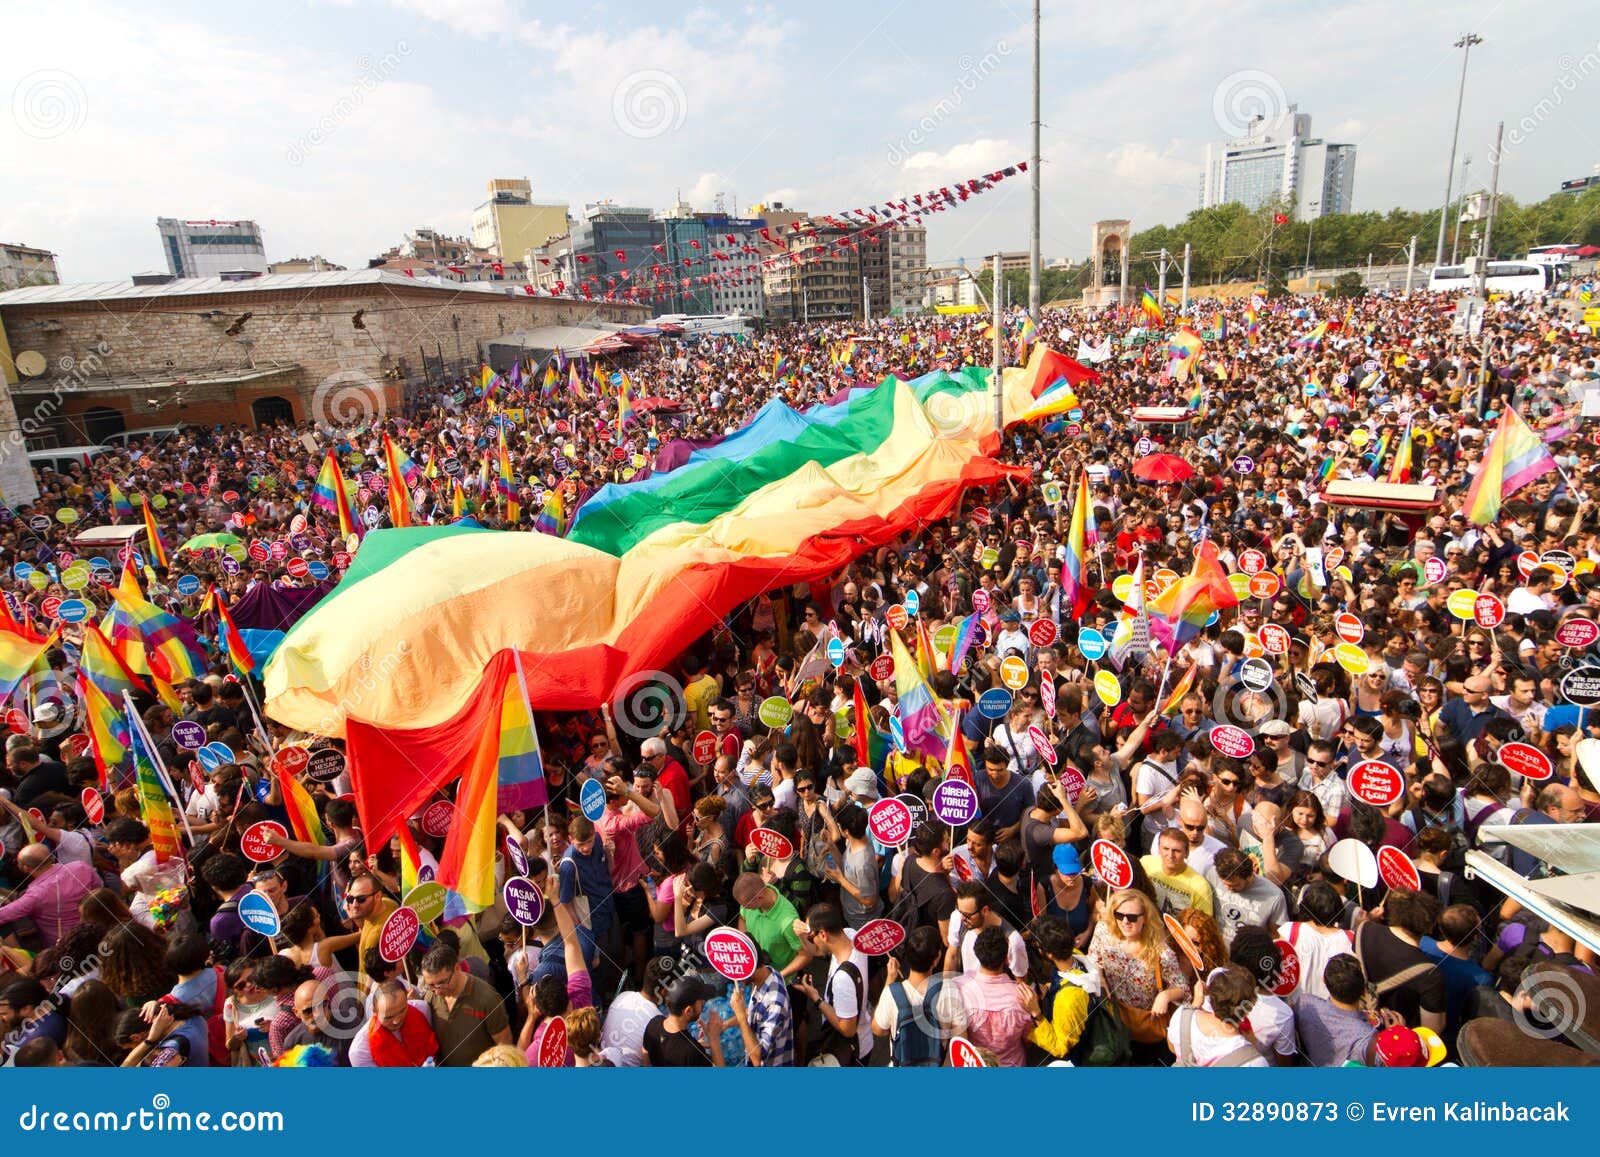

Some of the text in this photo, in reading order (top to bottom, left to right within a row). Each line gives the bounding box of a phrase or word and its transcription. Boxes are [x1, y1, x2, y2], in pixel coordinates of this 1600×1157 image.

[174, 726, 200, 736] YASAK
[941, 796, 969, 808] YORUZ
[872, 804, 900, 824] GENEL
[940, 807, 968, 819] AYOL!
[876, 811, 906, 834] AHLAK-
[887, 824, 906, 839] SIZ!
[508, 887, 536, 902] YASAK
[517, 900, 529, 910] NE
[857, 922, 893, 943] GENEL
[710, 940, 744, 953] GENEL
[713, 952, 750, 964] AHLAK-
[722, 962, 745, 975] SIZ!
